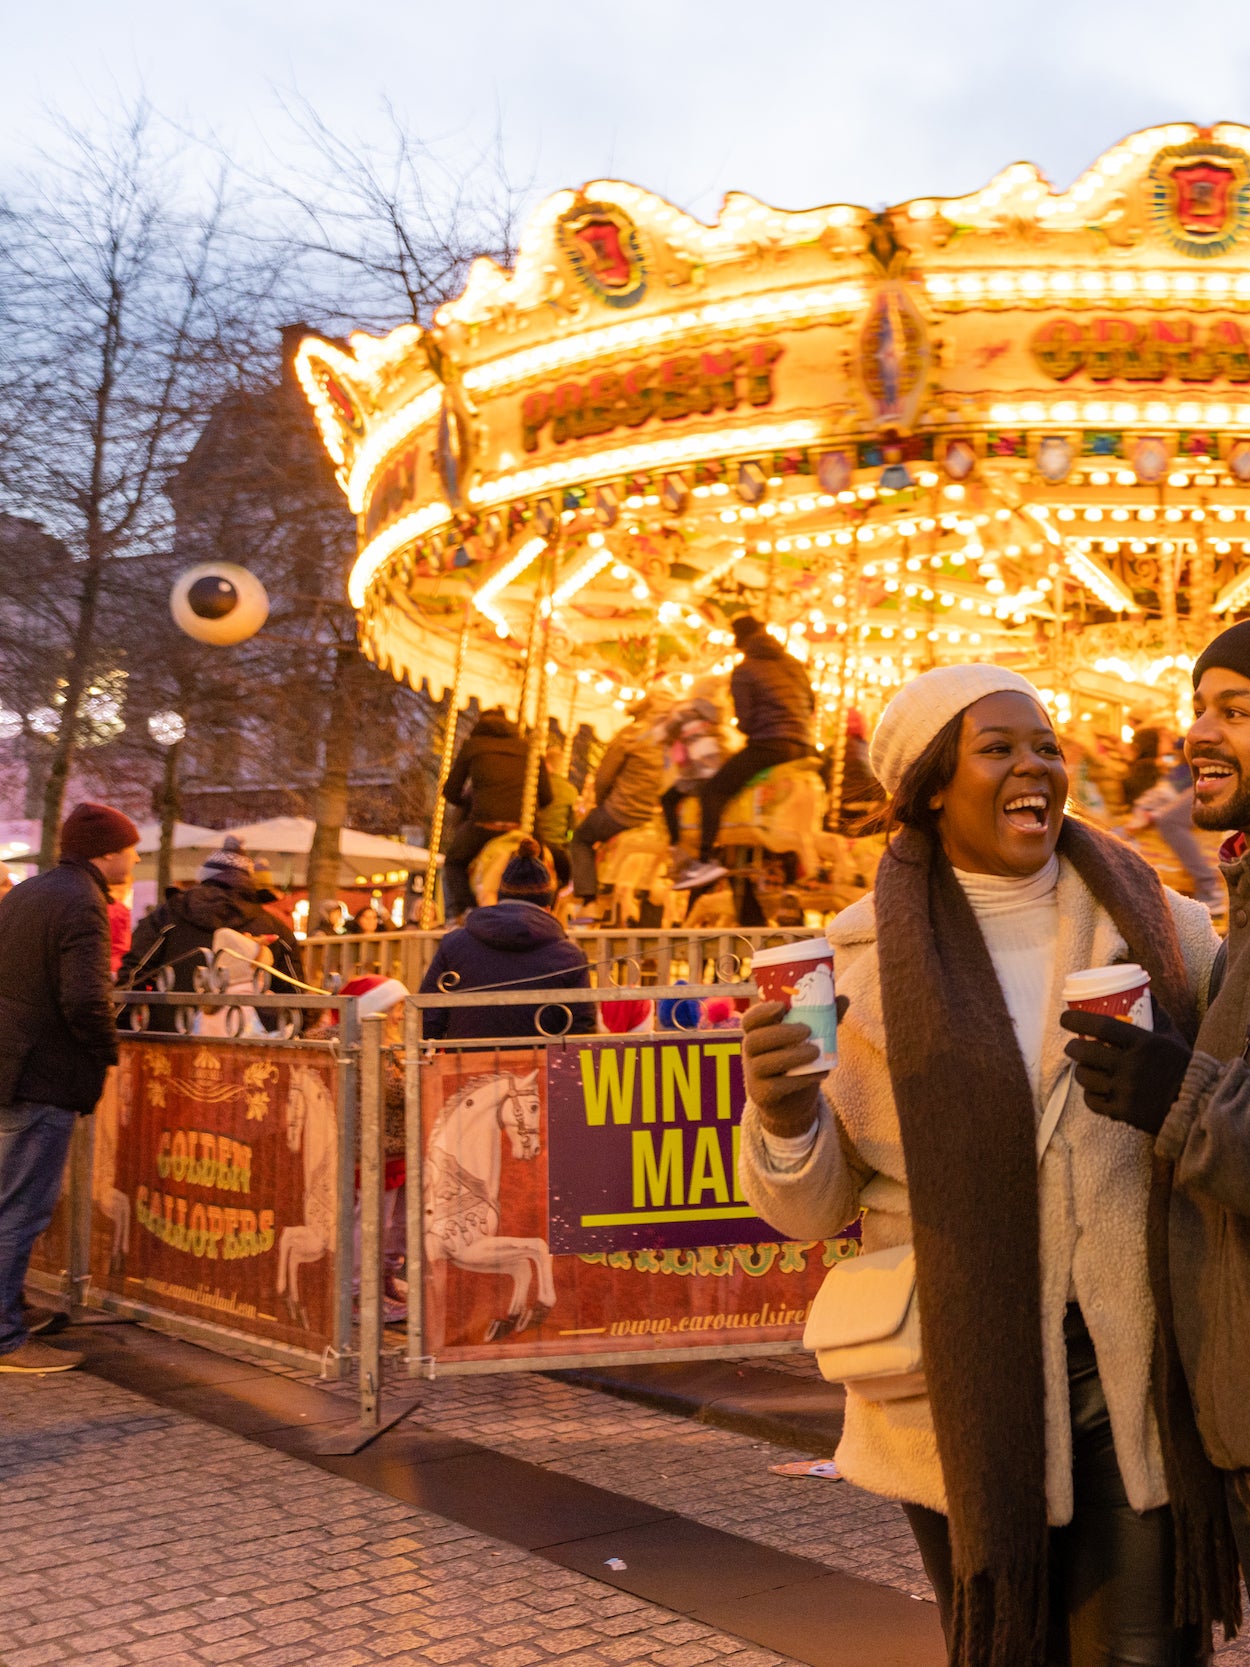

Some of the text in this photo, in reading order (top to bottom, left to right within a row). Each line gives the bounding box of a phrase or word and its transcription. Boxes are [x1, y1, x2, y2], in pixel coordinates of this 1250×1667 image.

[579, 1043, 742, 1126] WINT
[157, 1130, 252, 1194] GOLDEN
[136, 1185, 275, 1260] GALLOPERS
[609, 1302, 814, 1337] www.carouselsirel
